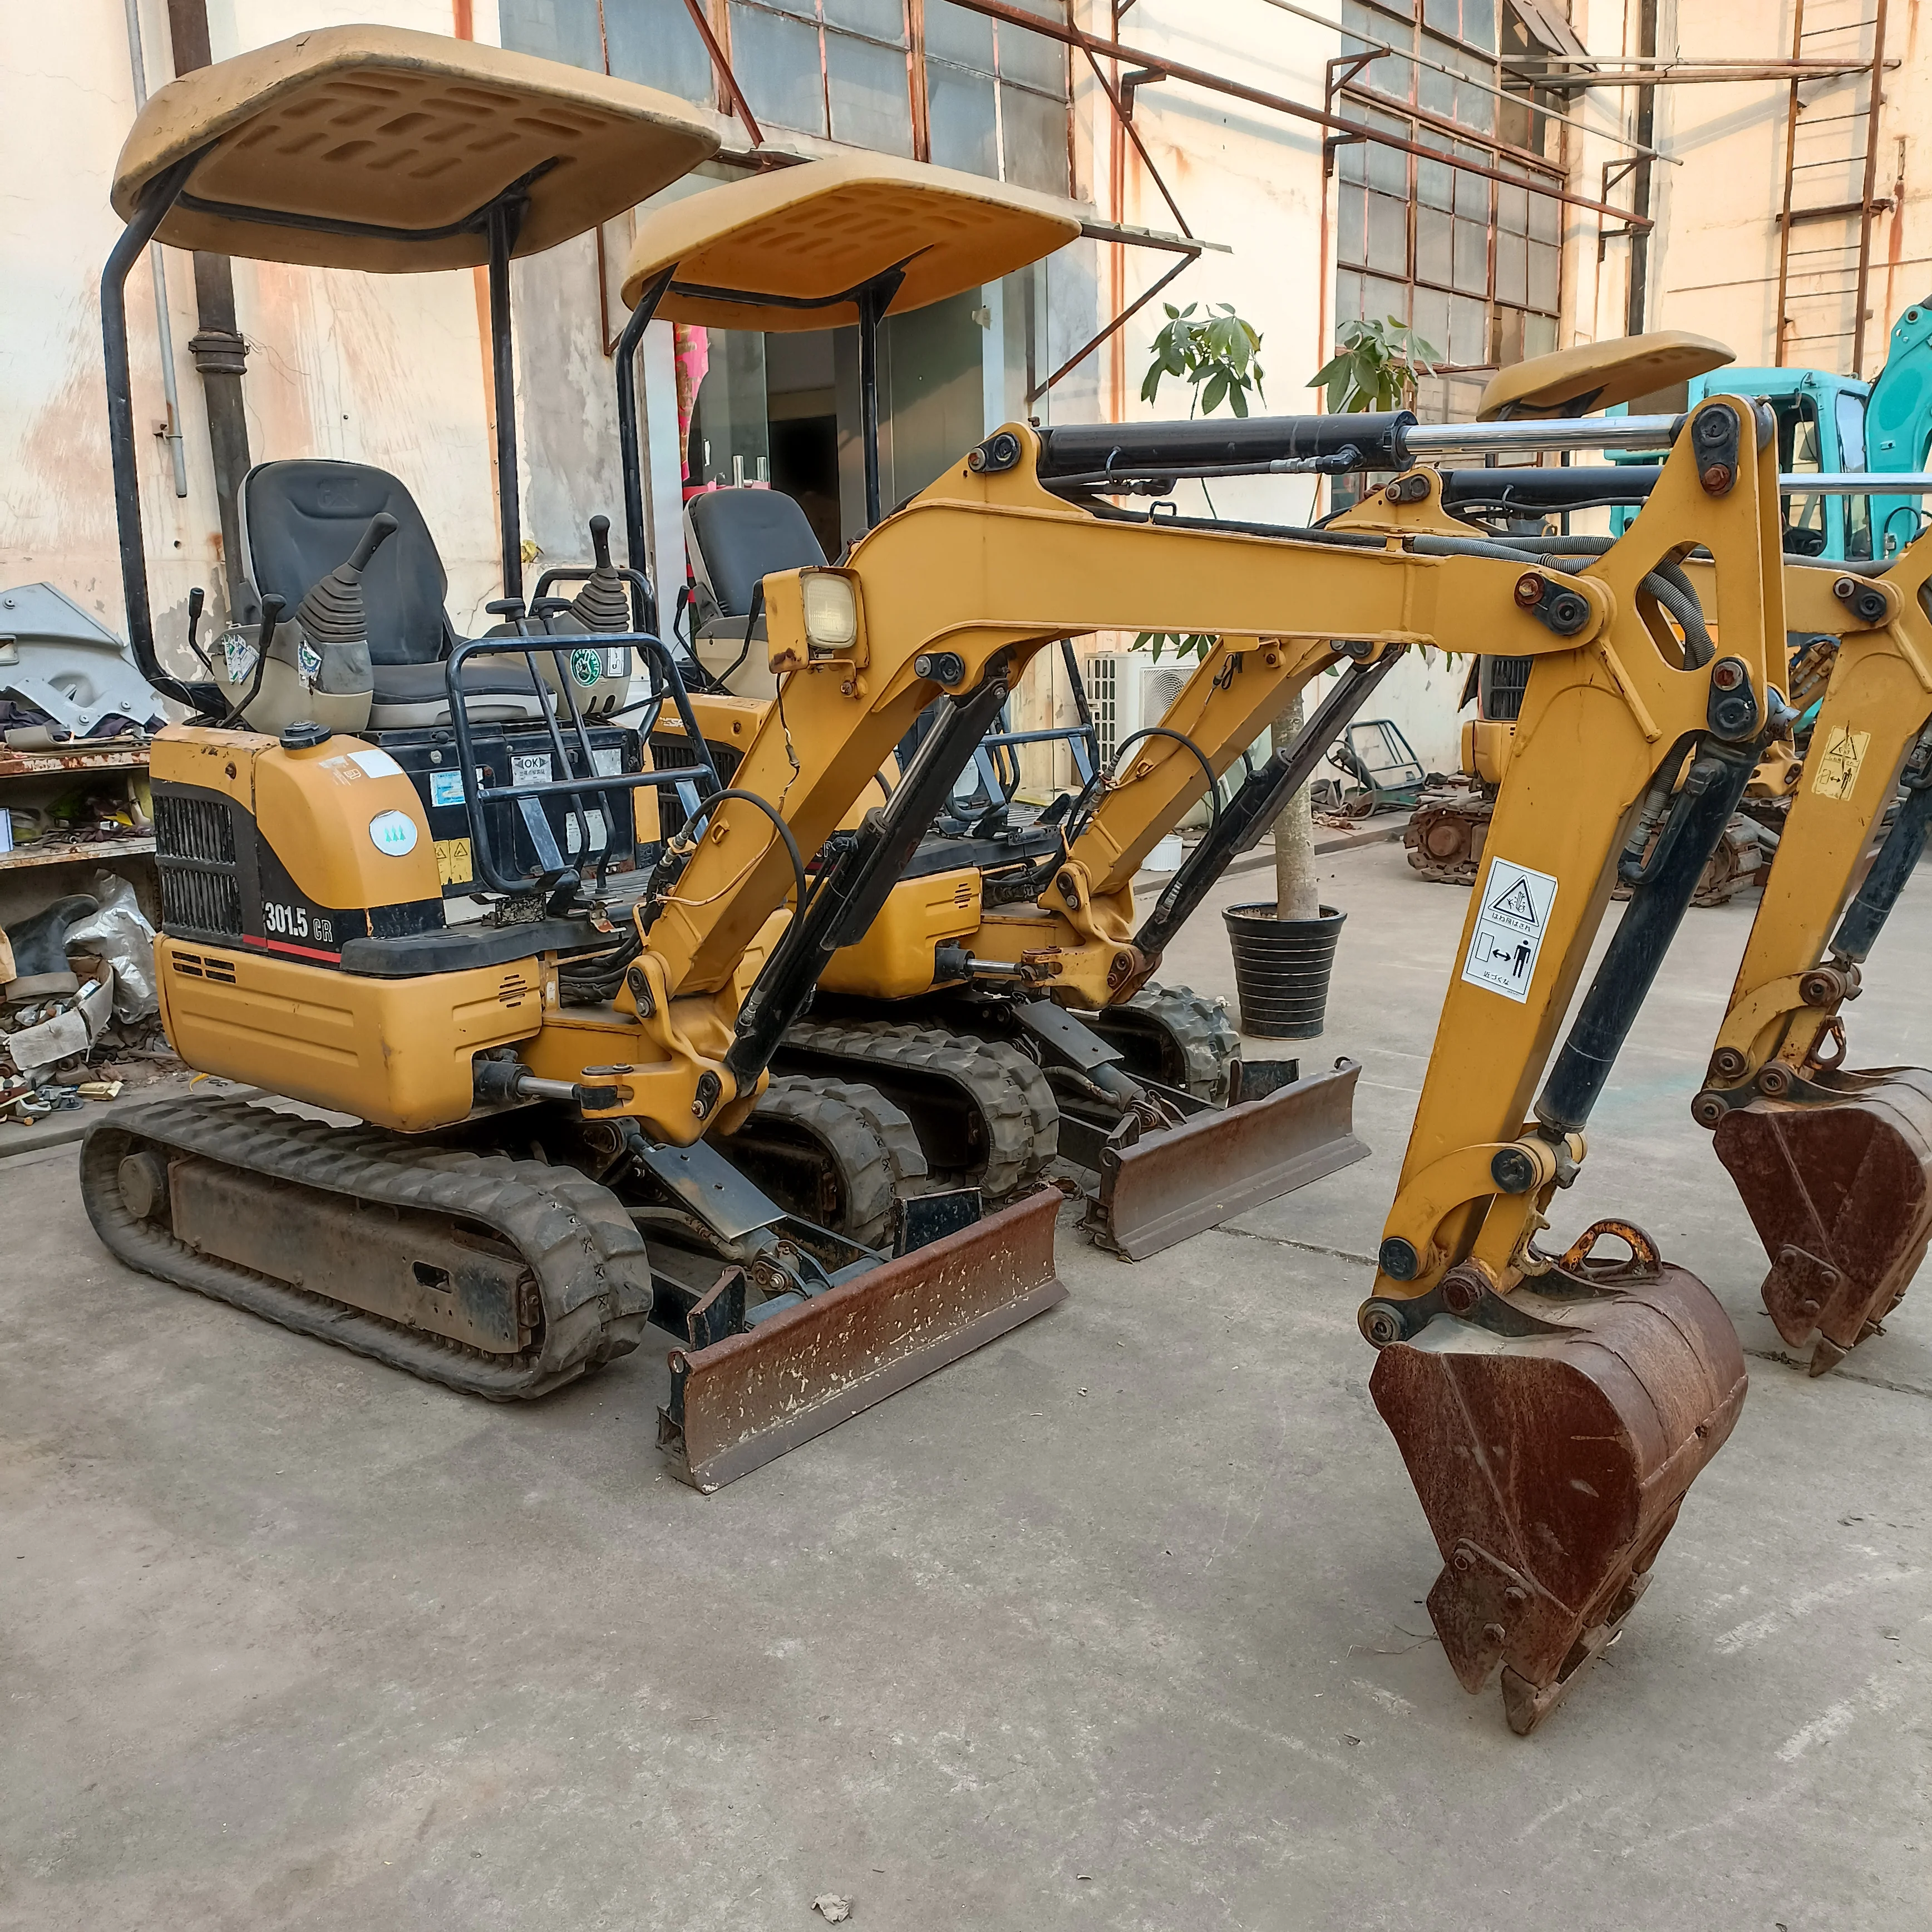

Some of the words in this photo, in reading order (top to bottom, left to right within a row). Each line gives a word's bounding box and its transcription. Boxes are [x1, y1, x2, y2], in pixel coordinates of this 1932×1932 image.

[524, 758, 539, 768] OK
[265, 902, 308, 937] 301.5
[313, 918, 333, 942] CR
